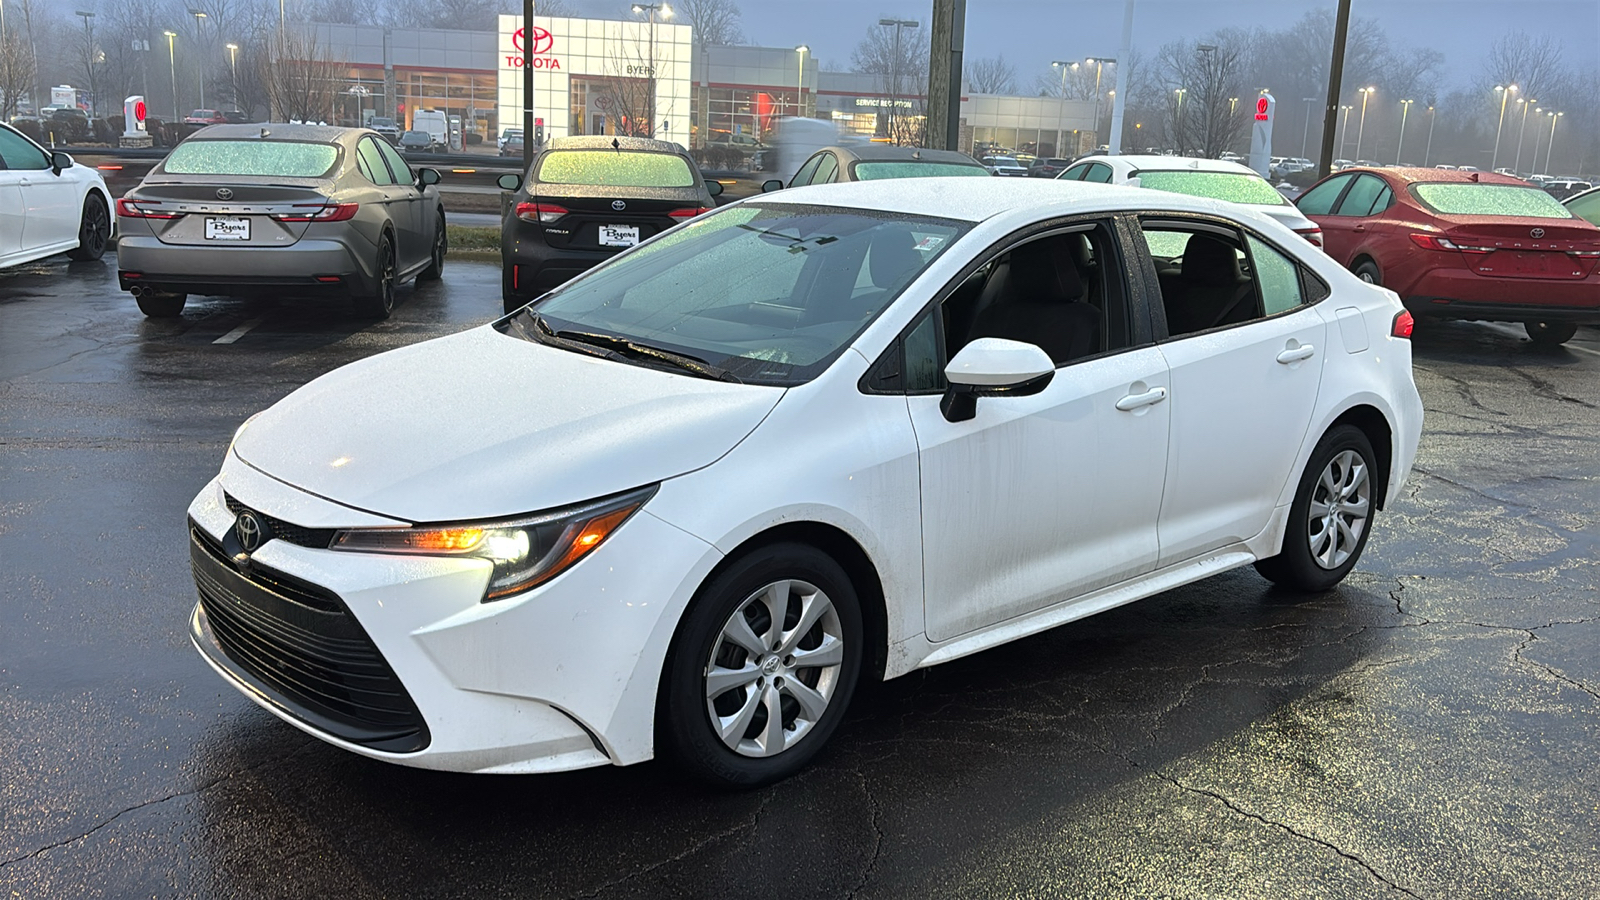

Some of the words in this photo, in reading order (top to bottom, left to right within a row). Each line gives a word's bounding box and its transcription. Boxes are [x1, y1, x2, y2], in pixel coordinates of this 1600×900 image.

[505, 56, 561, 69] TOOTA
[626, 65, 655, 76] BYERS
[855, 98, 879, 107] SERVICE
[210, 221, 246, 233] Byers
[602, 228, 636, 240] Byers
